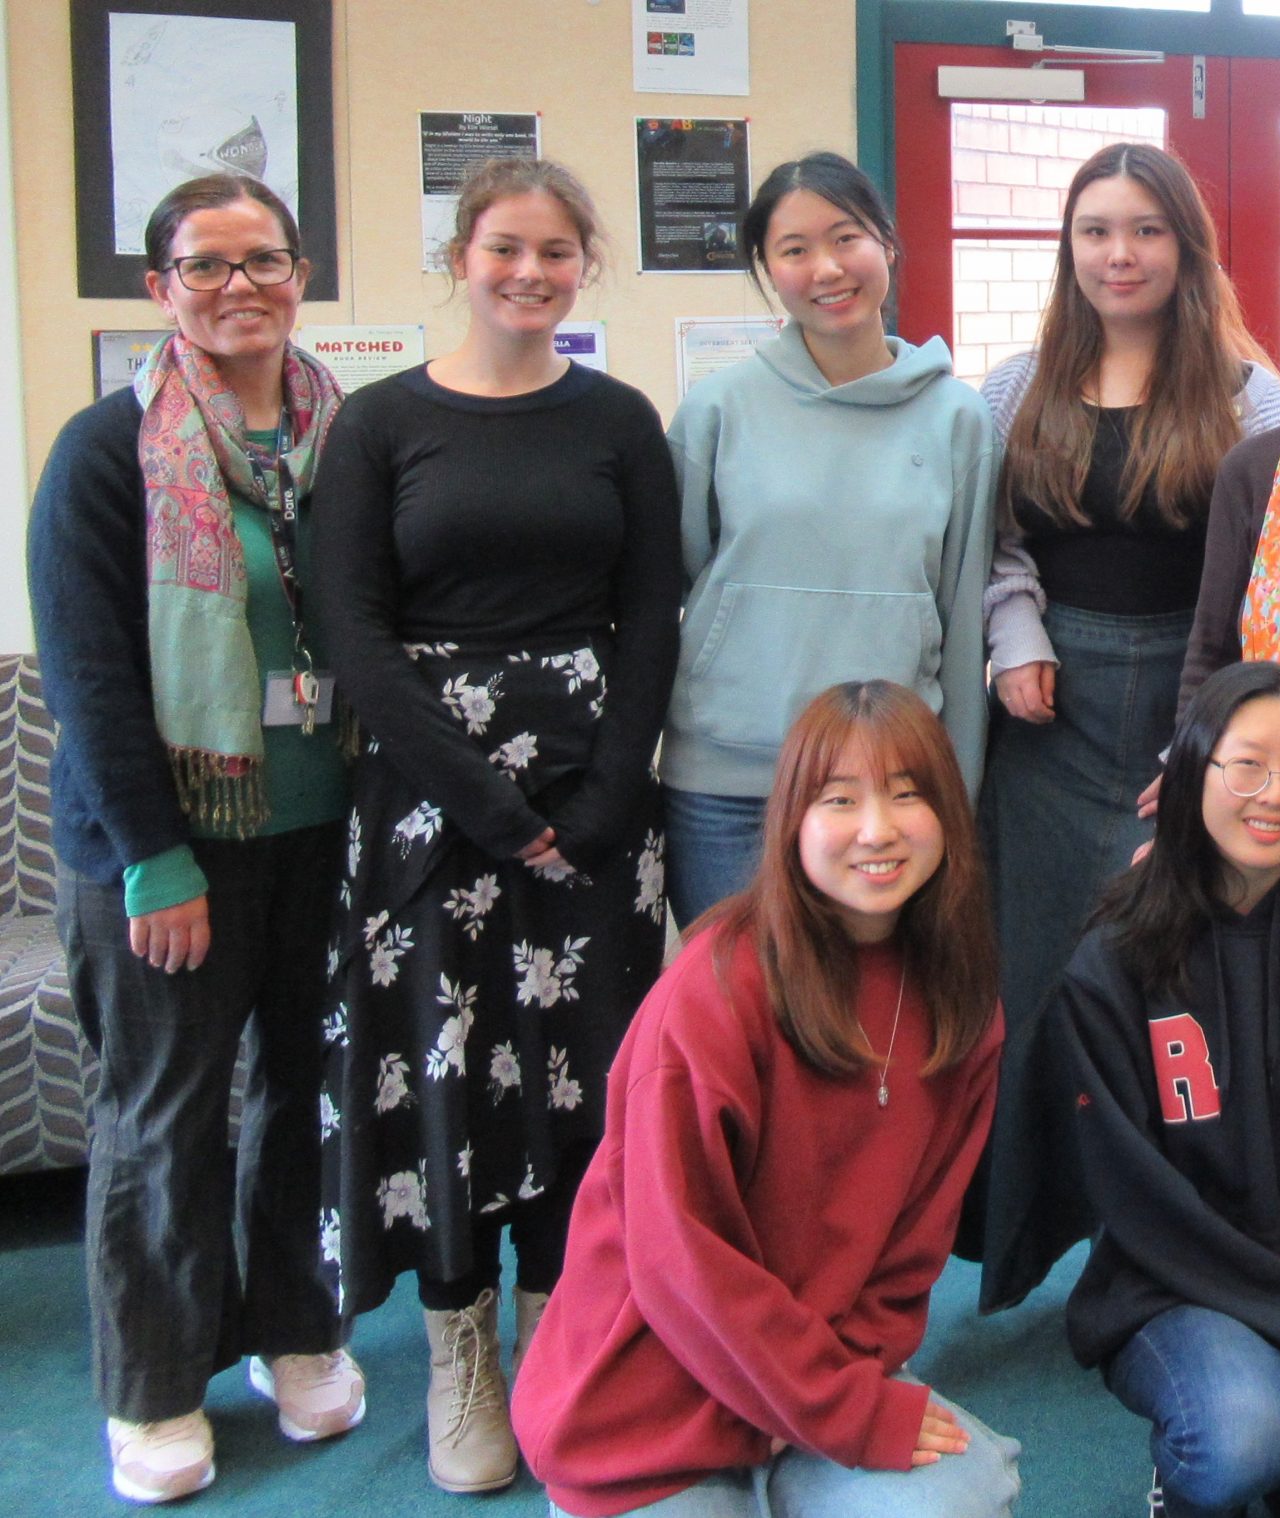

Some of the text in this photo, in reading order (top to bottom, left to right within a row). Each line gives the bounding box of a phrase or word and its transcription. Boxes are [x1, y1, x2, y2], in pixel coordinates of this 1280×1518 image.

[463, 114, 492, 124] Night
[315, 341, 403, 353] MATCHED
[284, 488, 295, 520] Dare.
[1148, 1012, 1222, 1123] R
